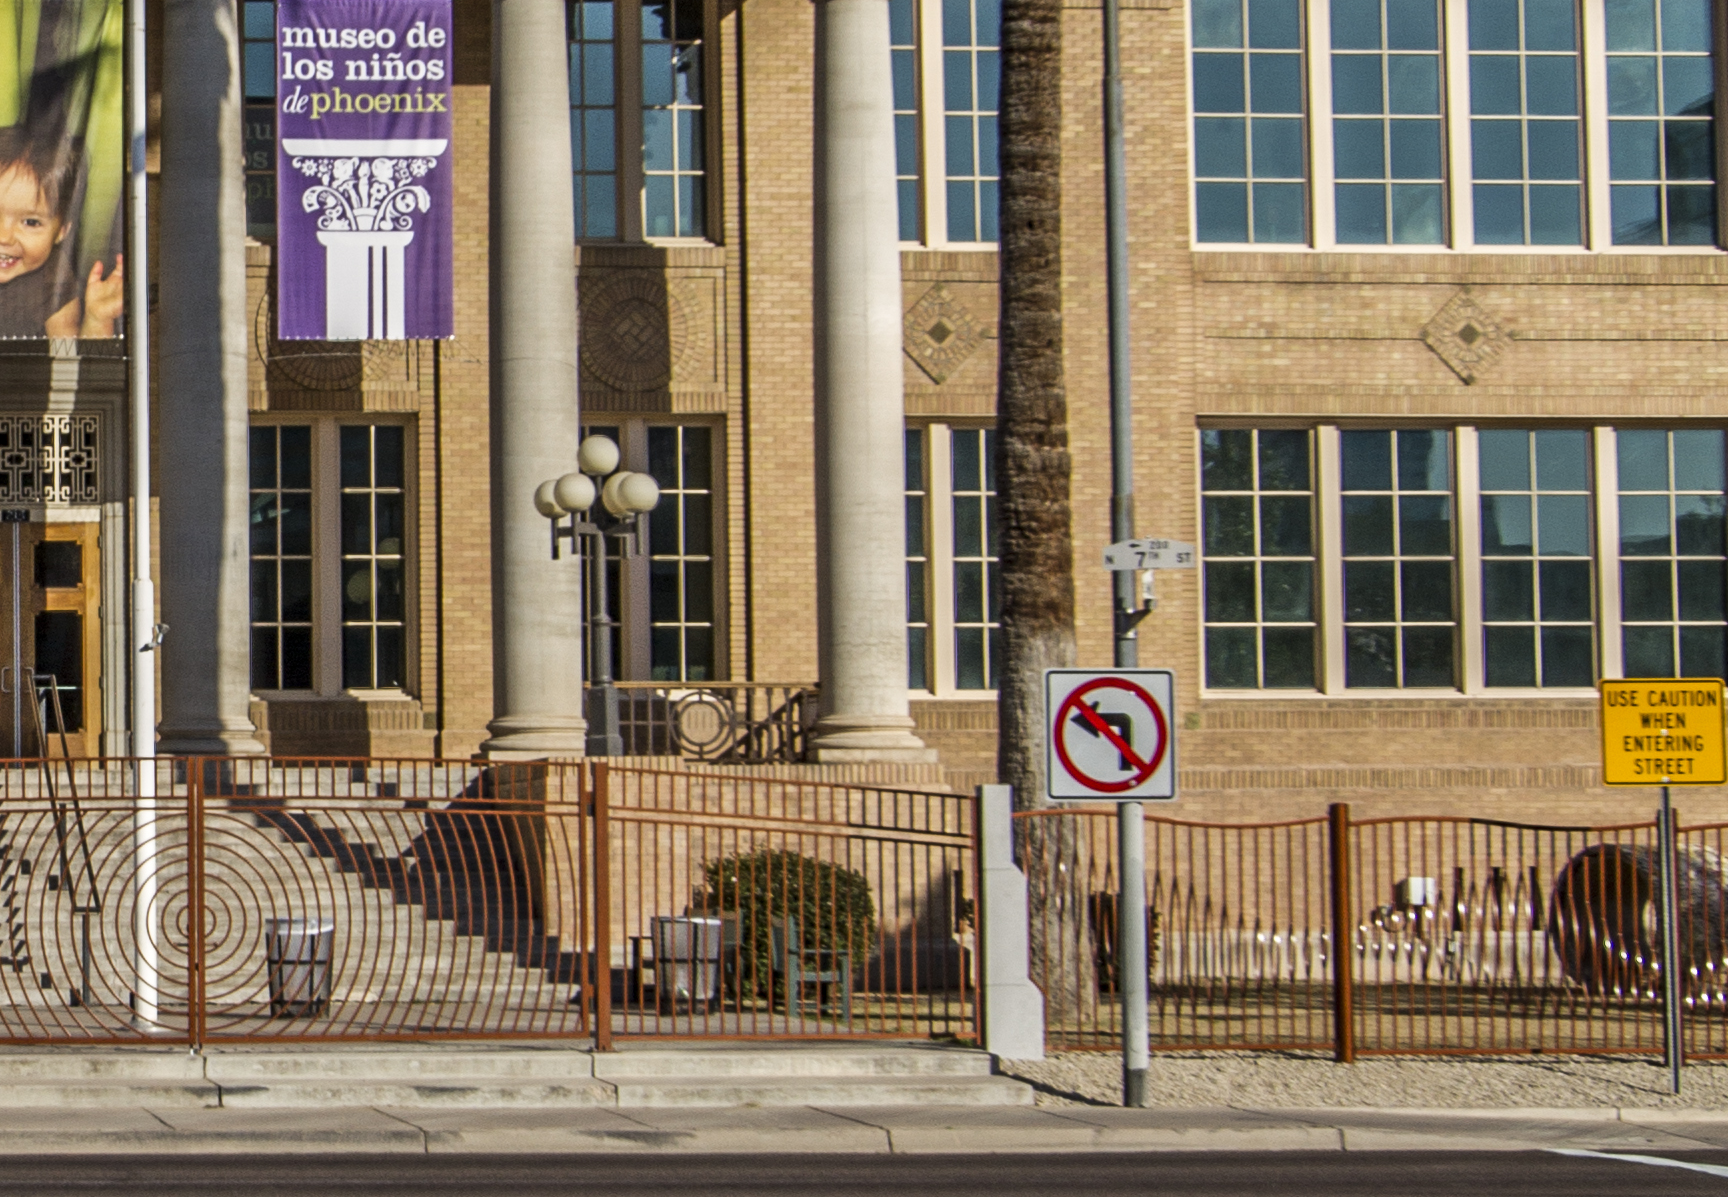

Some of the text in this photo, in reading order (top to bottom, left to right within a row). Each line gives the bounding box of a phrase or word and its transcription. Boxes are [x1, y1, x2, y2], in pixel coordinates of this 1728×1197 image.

[281, 21, 446, 49] museo de
[281, 51, 445, 81] los niños
[282, 84, 448, 120] de phoenix
[1104, 554, 1115, 565] N
[1175, 551, 1192, 564] ST
[1606, 690, 1718, 707] USE CAUTION
[1639, 712, 1686, 729] WHEN
[1623, 734, 1705, 752] ENTERING
[1633, 757, 1696, 775] STREET
